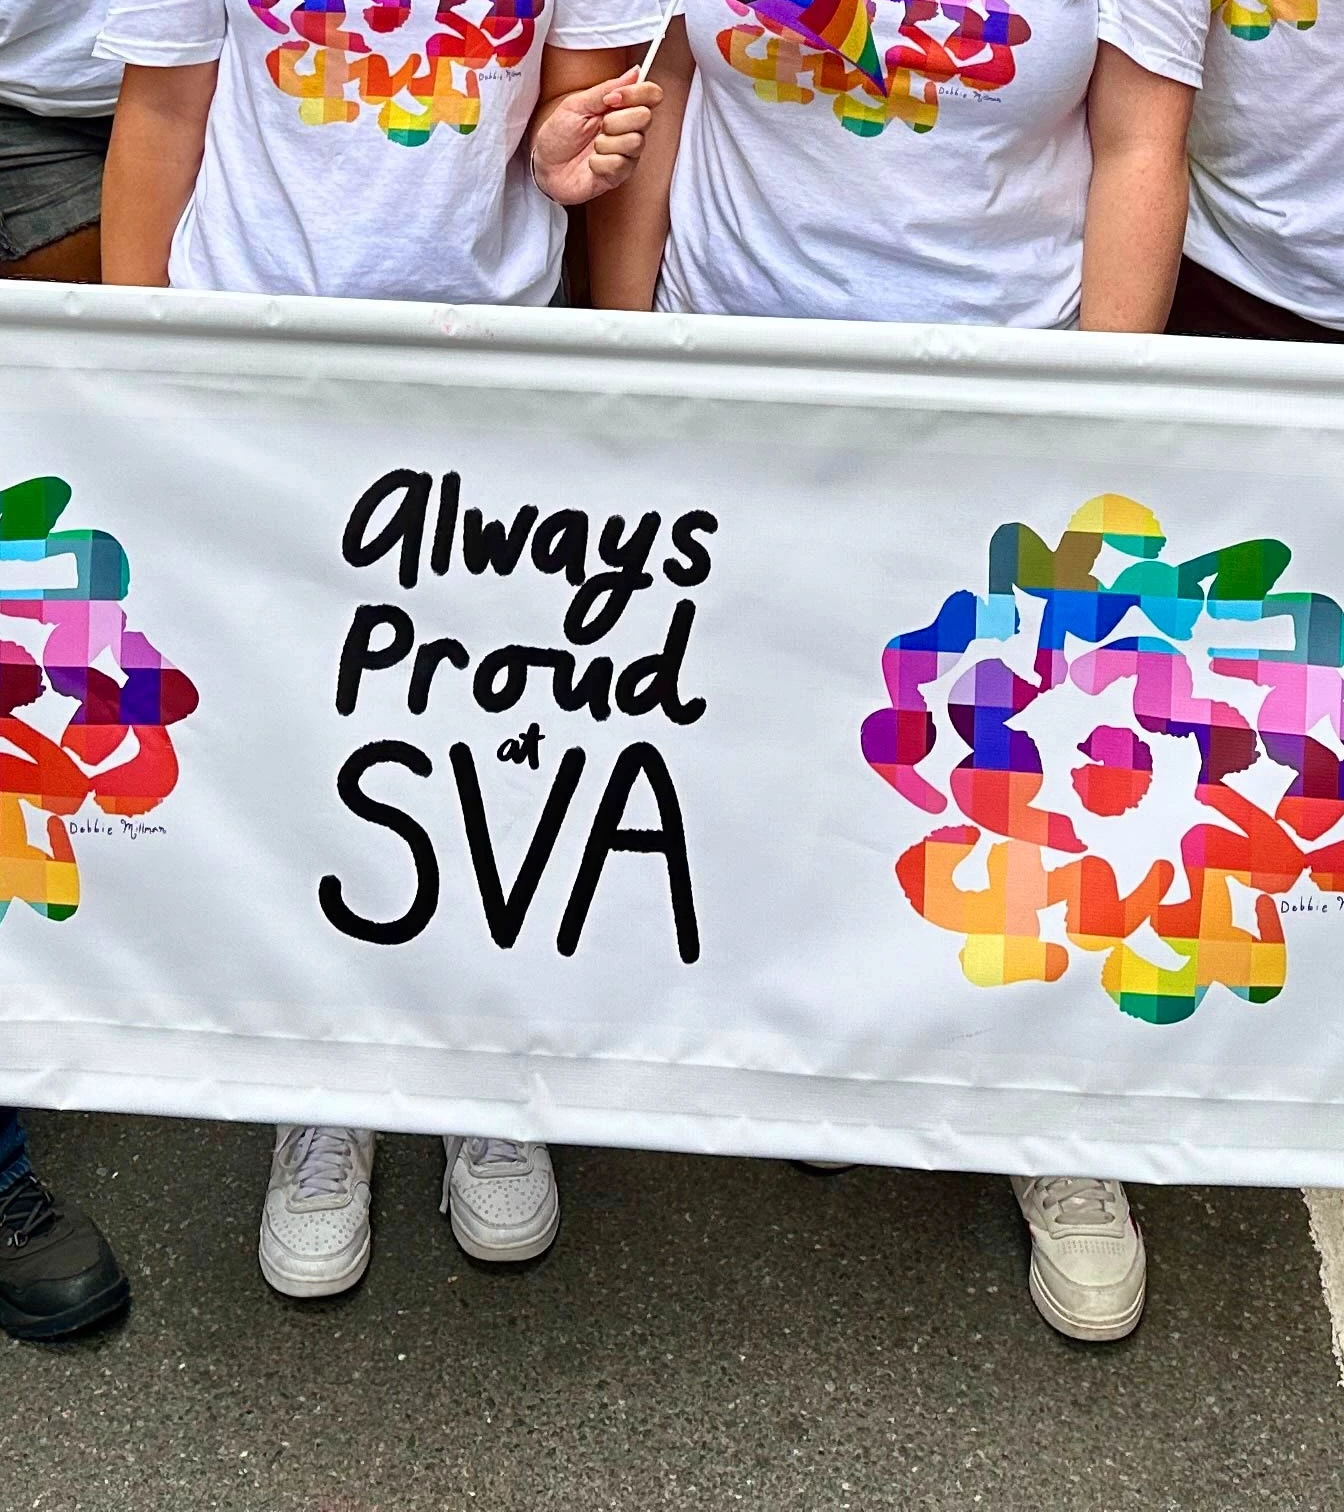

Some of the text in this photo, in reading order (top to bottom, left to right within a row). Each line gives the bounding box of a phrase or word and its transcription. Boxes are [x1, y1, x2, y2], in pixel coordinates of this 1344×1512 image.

[335, 598, 707, 725] Proud
[496, 722, 545, 770] at
[69, 818, 167, 840] Debbie Millman
[318, 739, 701, 965] SVA
[1280, 895, 1328, 914] Debbie
